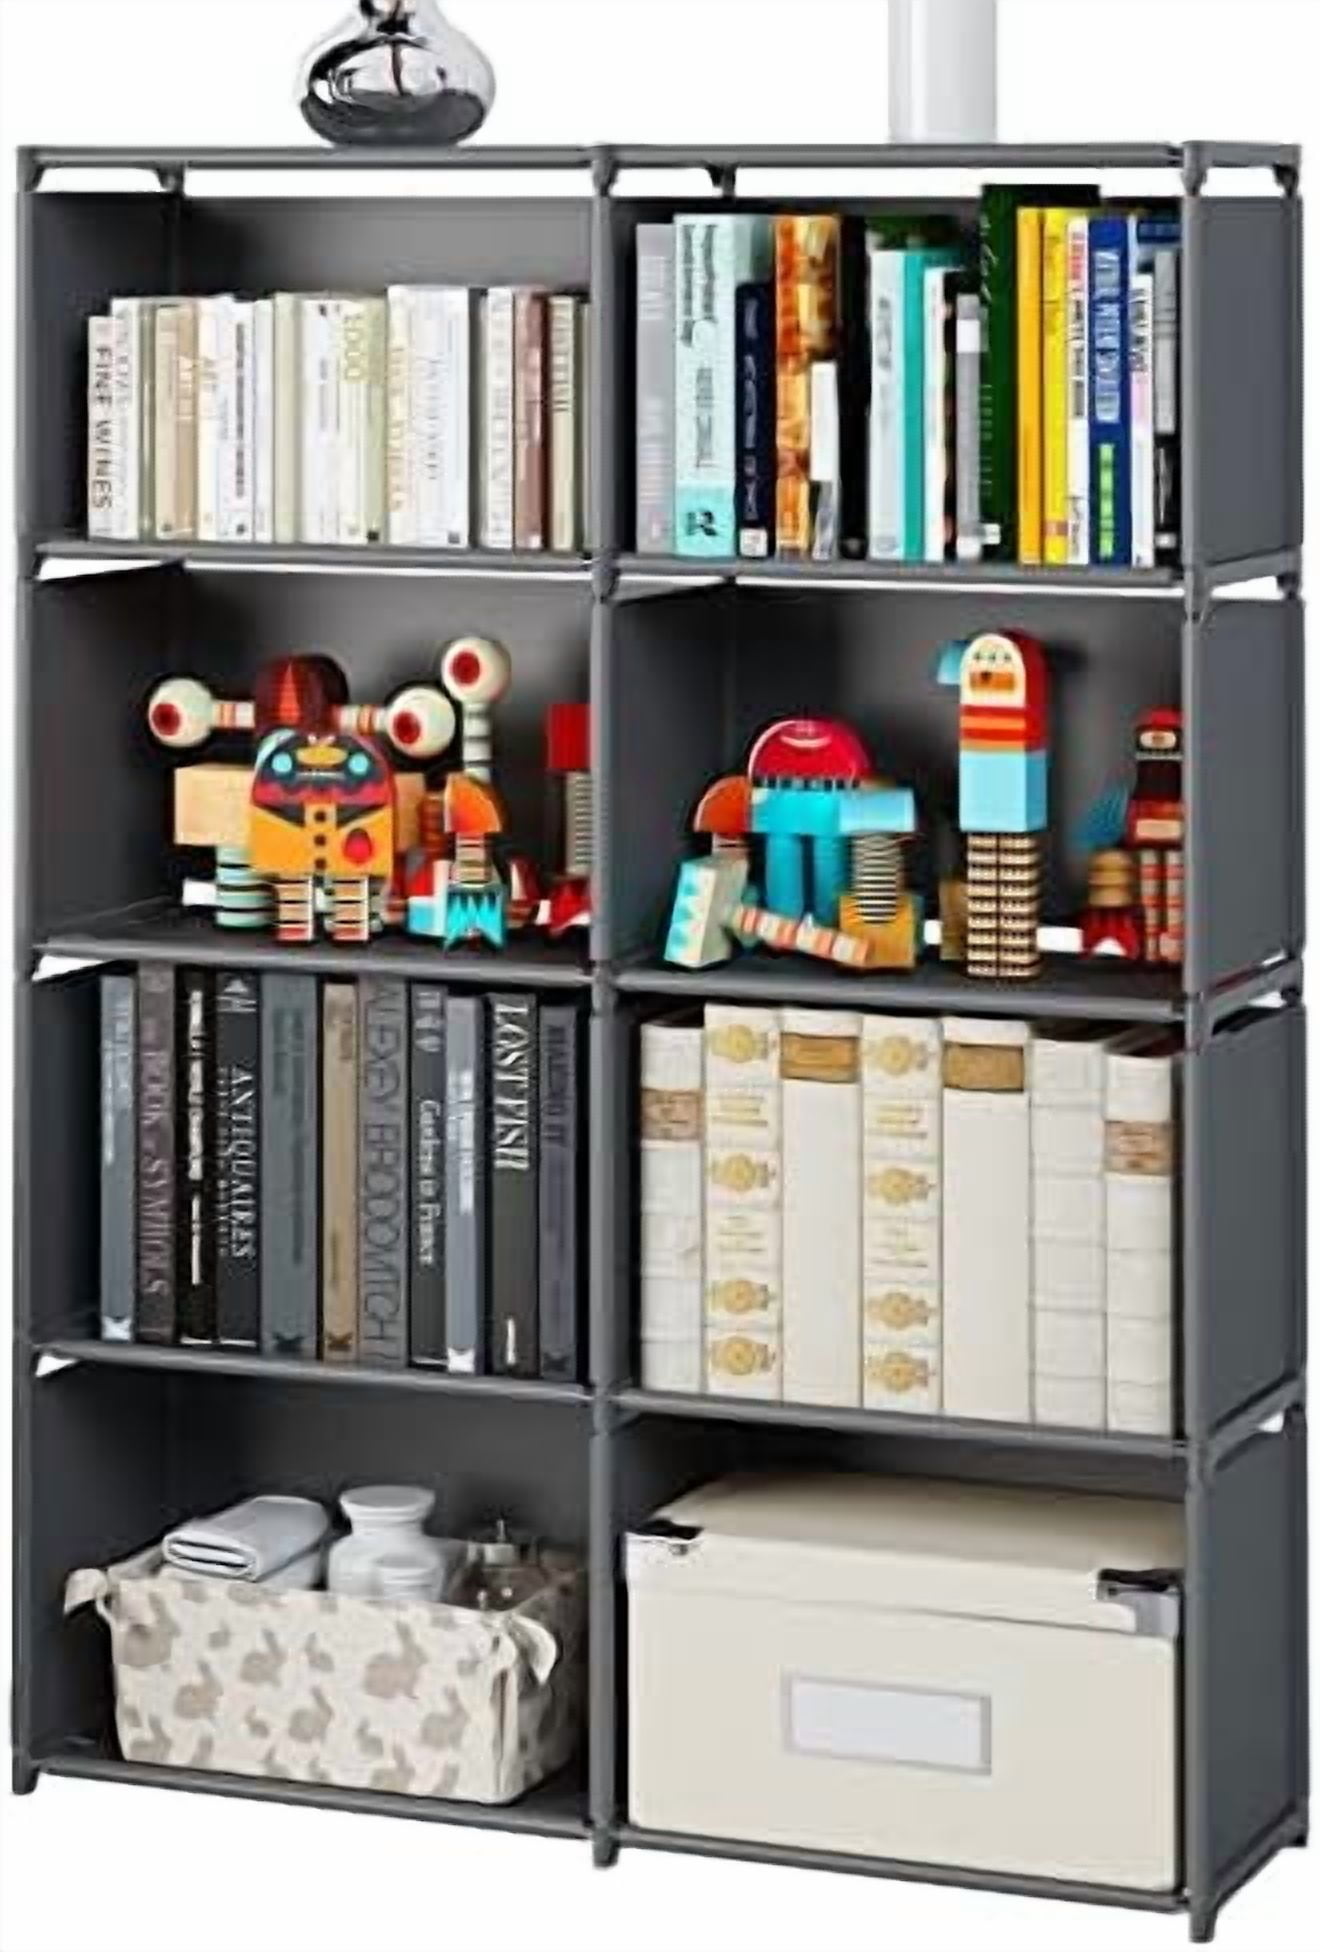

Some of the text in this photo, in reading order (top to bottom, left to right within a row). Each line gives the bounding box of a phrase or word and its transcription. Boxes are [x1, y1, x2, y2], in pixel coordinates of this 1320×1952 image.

[92, 346, 114, 510] FINE WINES
[231, 1067, 255, 1258] ANTIQUAIRES
[494, 1003, 529, 1170] LOST FISH
